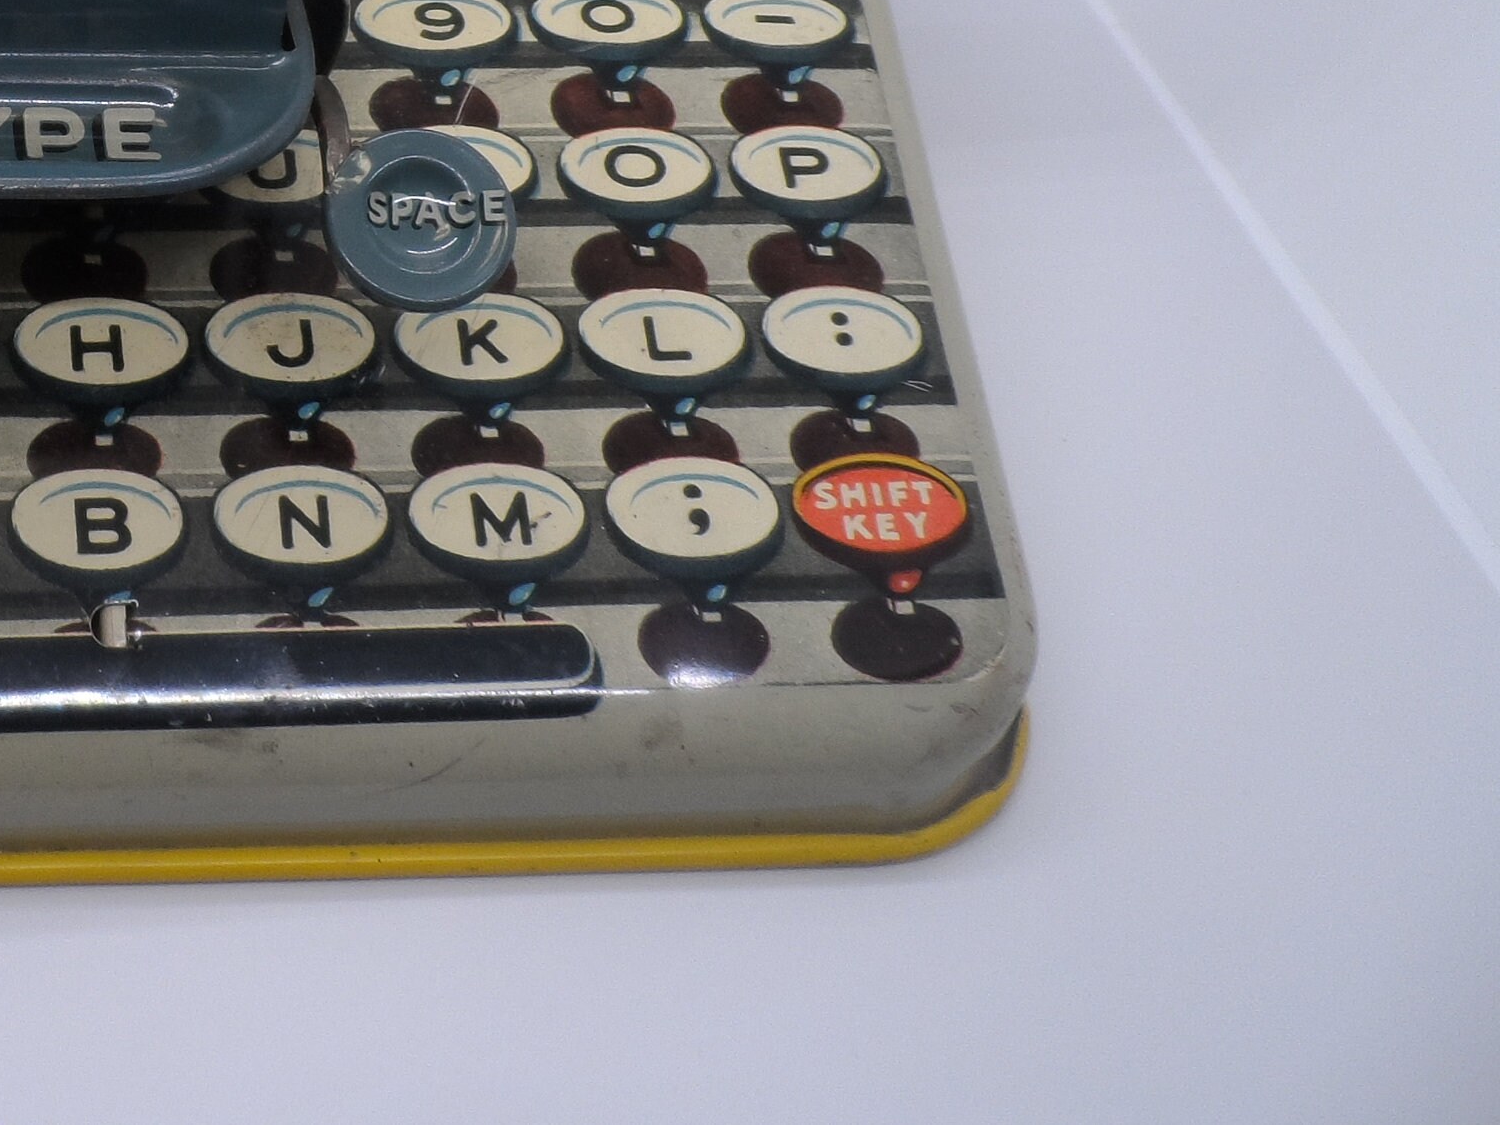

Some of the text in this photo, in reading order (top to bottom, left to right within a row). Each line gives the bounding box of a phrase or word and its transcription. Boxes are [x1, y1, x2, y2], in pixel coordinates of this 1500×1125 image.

[412, 0, 467, 42] 9
[602, 143, 668, 189] O
[777, 145, 831, 190] P
[366, 188, 508, 229] SPACE
[68, 323, 126, 374] H
[265, 317, 316, 369] J
[455, 317, 510, 368] K
[641, 314, 694, 363] L
[812, 480, 934, 511] SHIFT
[73, 496, 134, 556] B
[277, 493, 333, 551] N
[468, 490, 534, 549] M
[680, 481, 713, 537] ;
[842, 510, 928, 542] KEY
